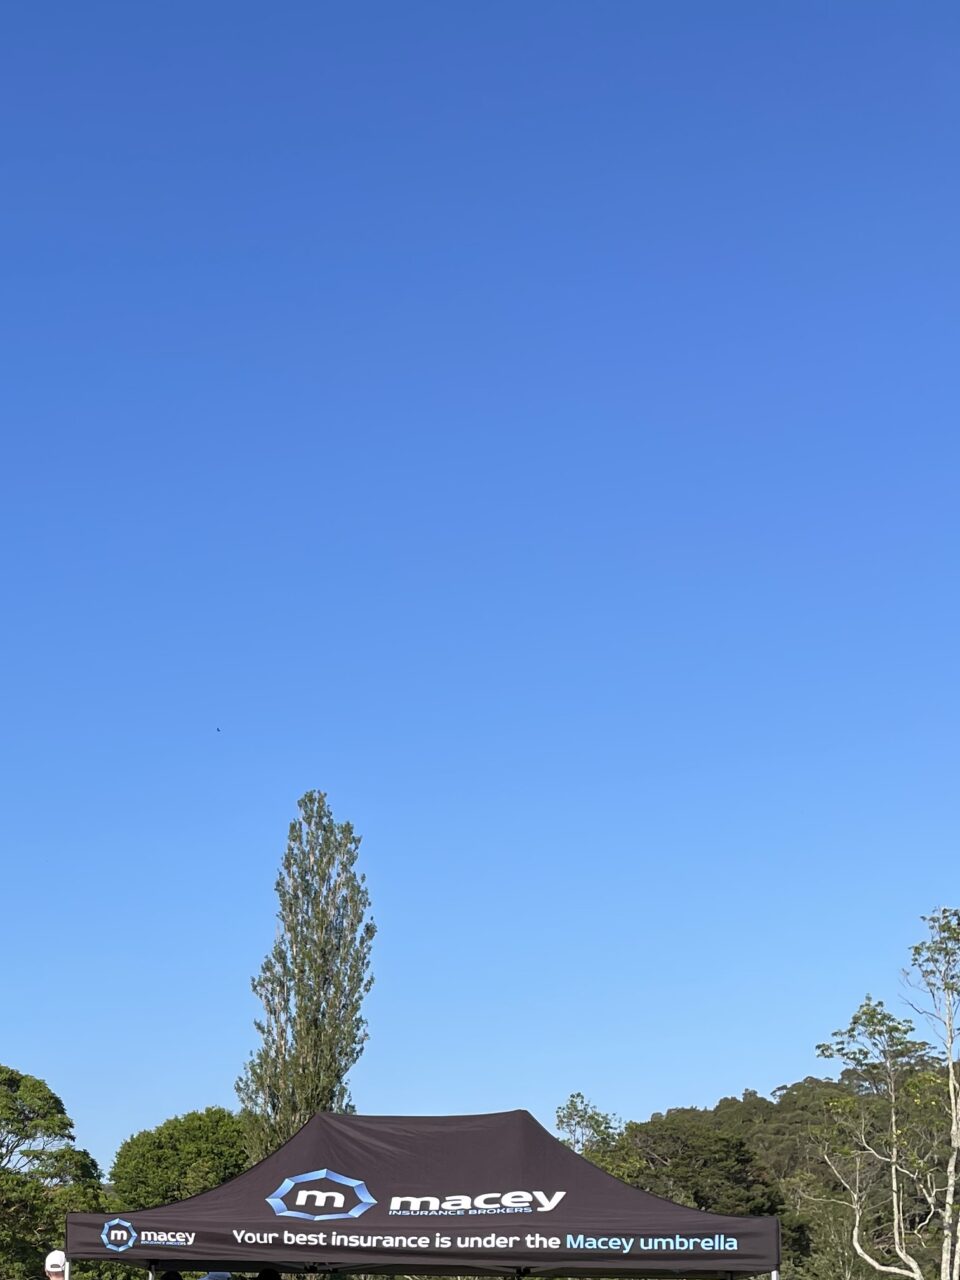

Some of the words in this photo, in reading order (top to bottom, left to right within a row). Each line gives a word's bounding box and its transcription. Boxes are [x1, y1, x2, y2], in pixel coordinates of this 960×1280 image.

[295, 1189, 346, 1208] m
[389, 1190, 567, 1212] macey
[468, 1206, 533, 1215] BROKERS
[110, 1229, 128, 1241] m
[140, 1230, 196, 1246] macey
[232, 1229, 279, 1244] Your
[283, 1230, 327, 1246] best
[331, 1231, 430, 1248] insurance
[434, 1232, 452, 1248] is
[456, 1233, 521, 1249] under
[524, 1233, 562, 1249] the
[566, 1234, 635, 1254] Macey
[640, 1234, 739, 1251] umbrella
